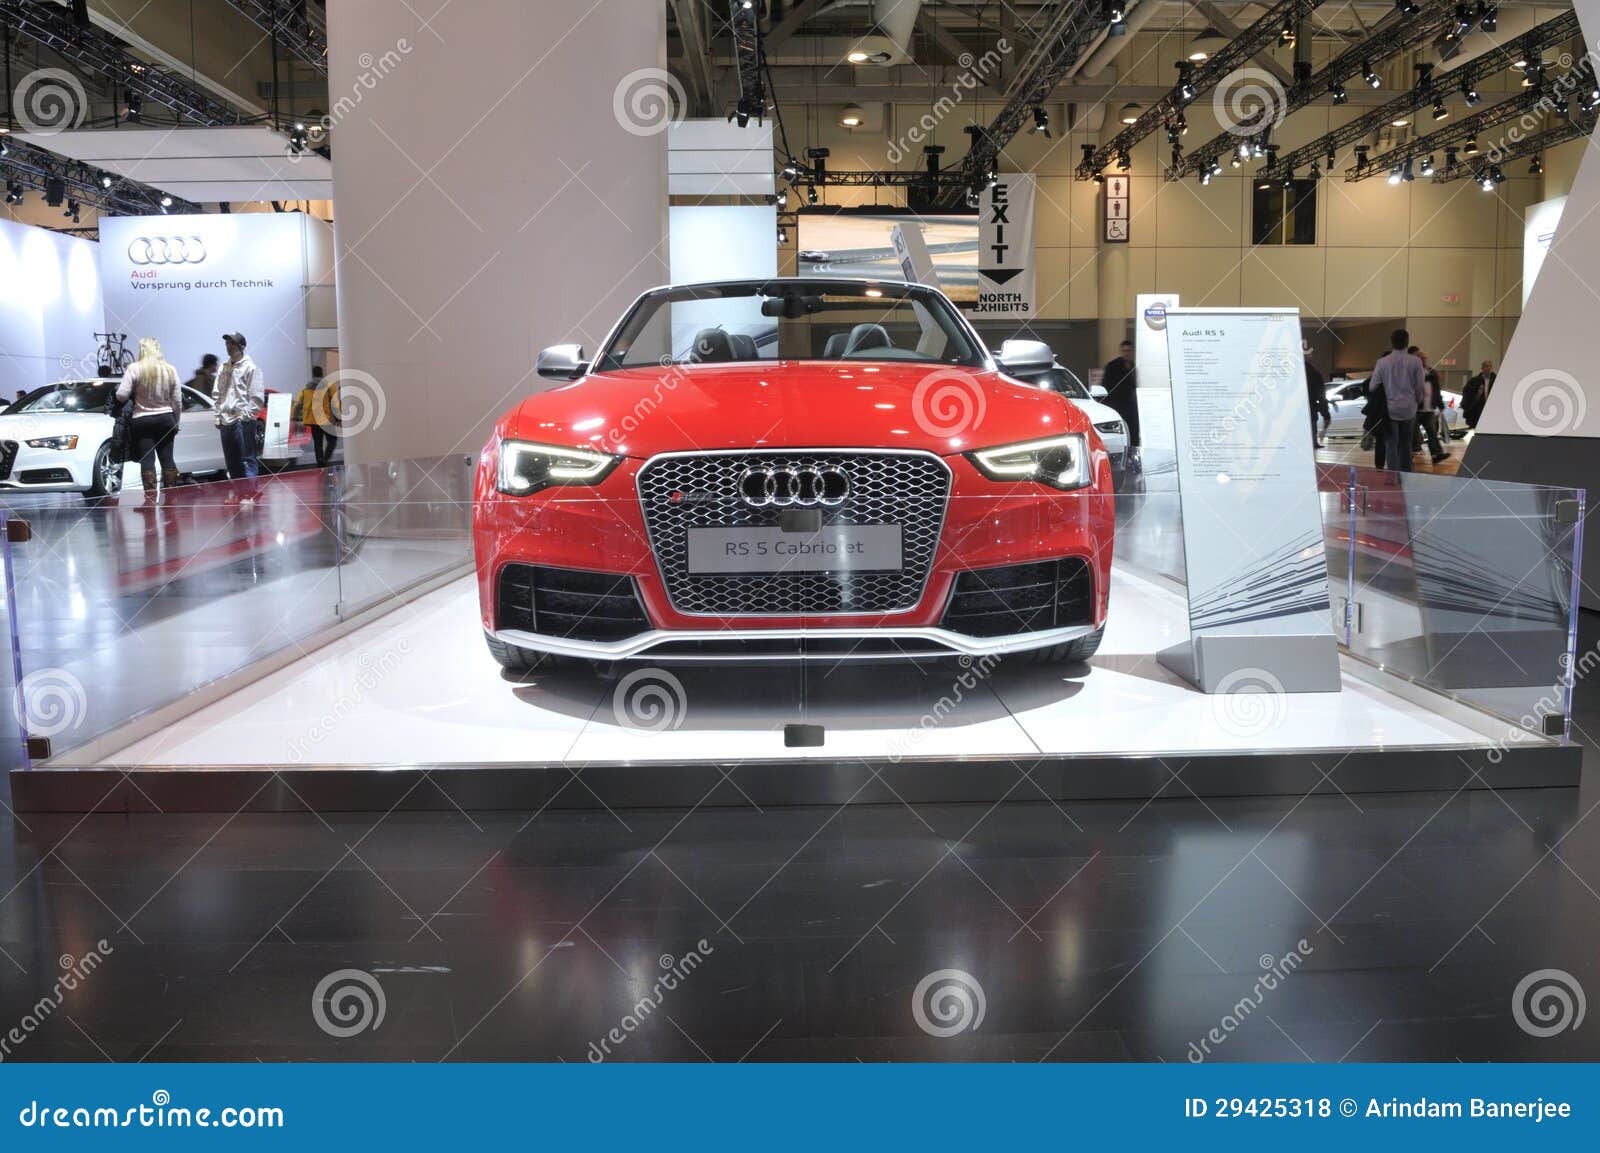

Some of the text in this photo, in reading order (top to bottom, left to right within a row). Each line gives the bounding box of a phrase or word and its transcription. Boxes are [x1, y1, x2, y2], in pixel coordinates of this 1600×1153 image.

[990, 184, 1010, 264] EXIT
[131, 270, 157, 279] Audi
[131, 279, 274, 291] Vorsprung durch Technik
[979, 293, 1022, 303] NORTH
[973, 303, 1029, 313] EXHIBITS
[1182, 329, 1202, 337] Audi
[725, 540, 865, 556] RS 5 Cabrioet
